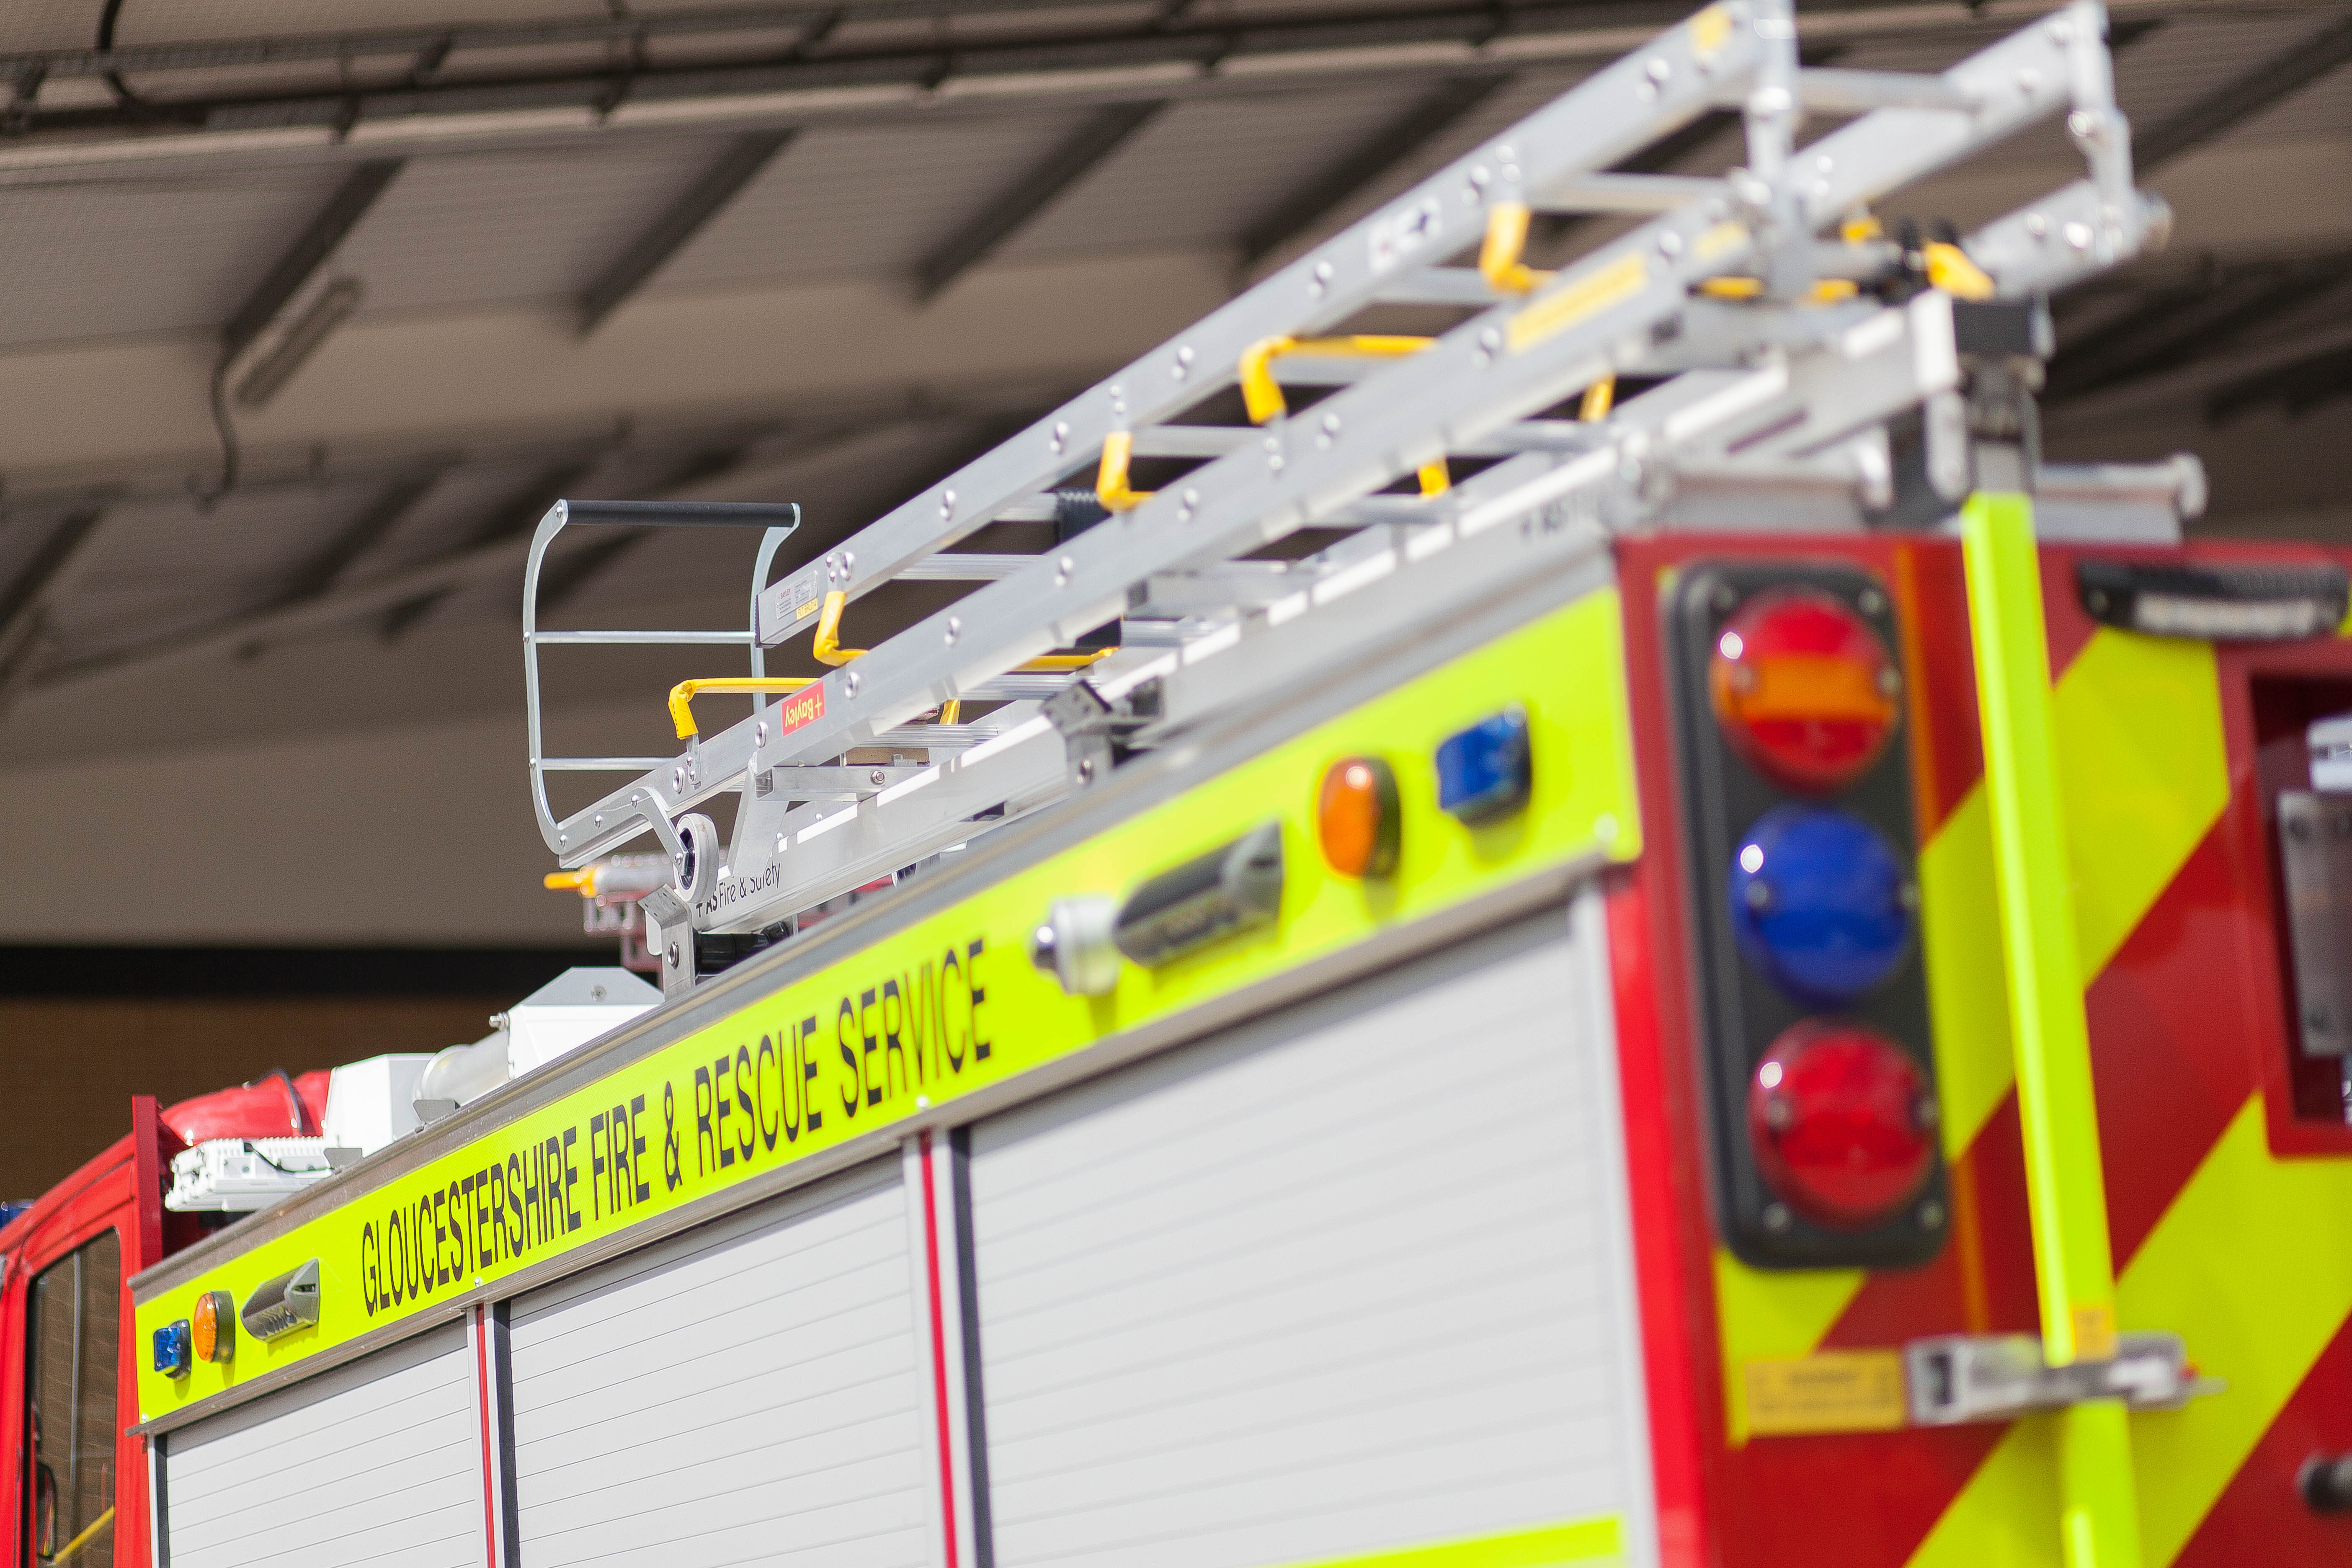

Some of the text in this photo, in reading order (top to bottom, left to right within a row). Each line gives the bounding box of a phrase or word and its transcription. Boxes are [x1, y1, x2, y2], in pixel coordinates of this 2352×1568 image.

[780, 588, 790, 599] BAYLEY
[785, 698, 814, 727] Bayley
[719, 882, 736, 908] Fire
[740, 877, 747, 898] &
[363, 939, 991, 1317] GLOUCESTERSHIRE FIRE & RESCUE SERVICE
